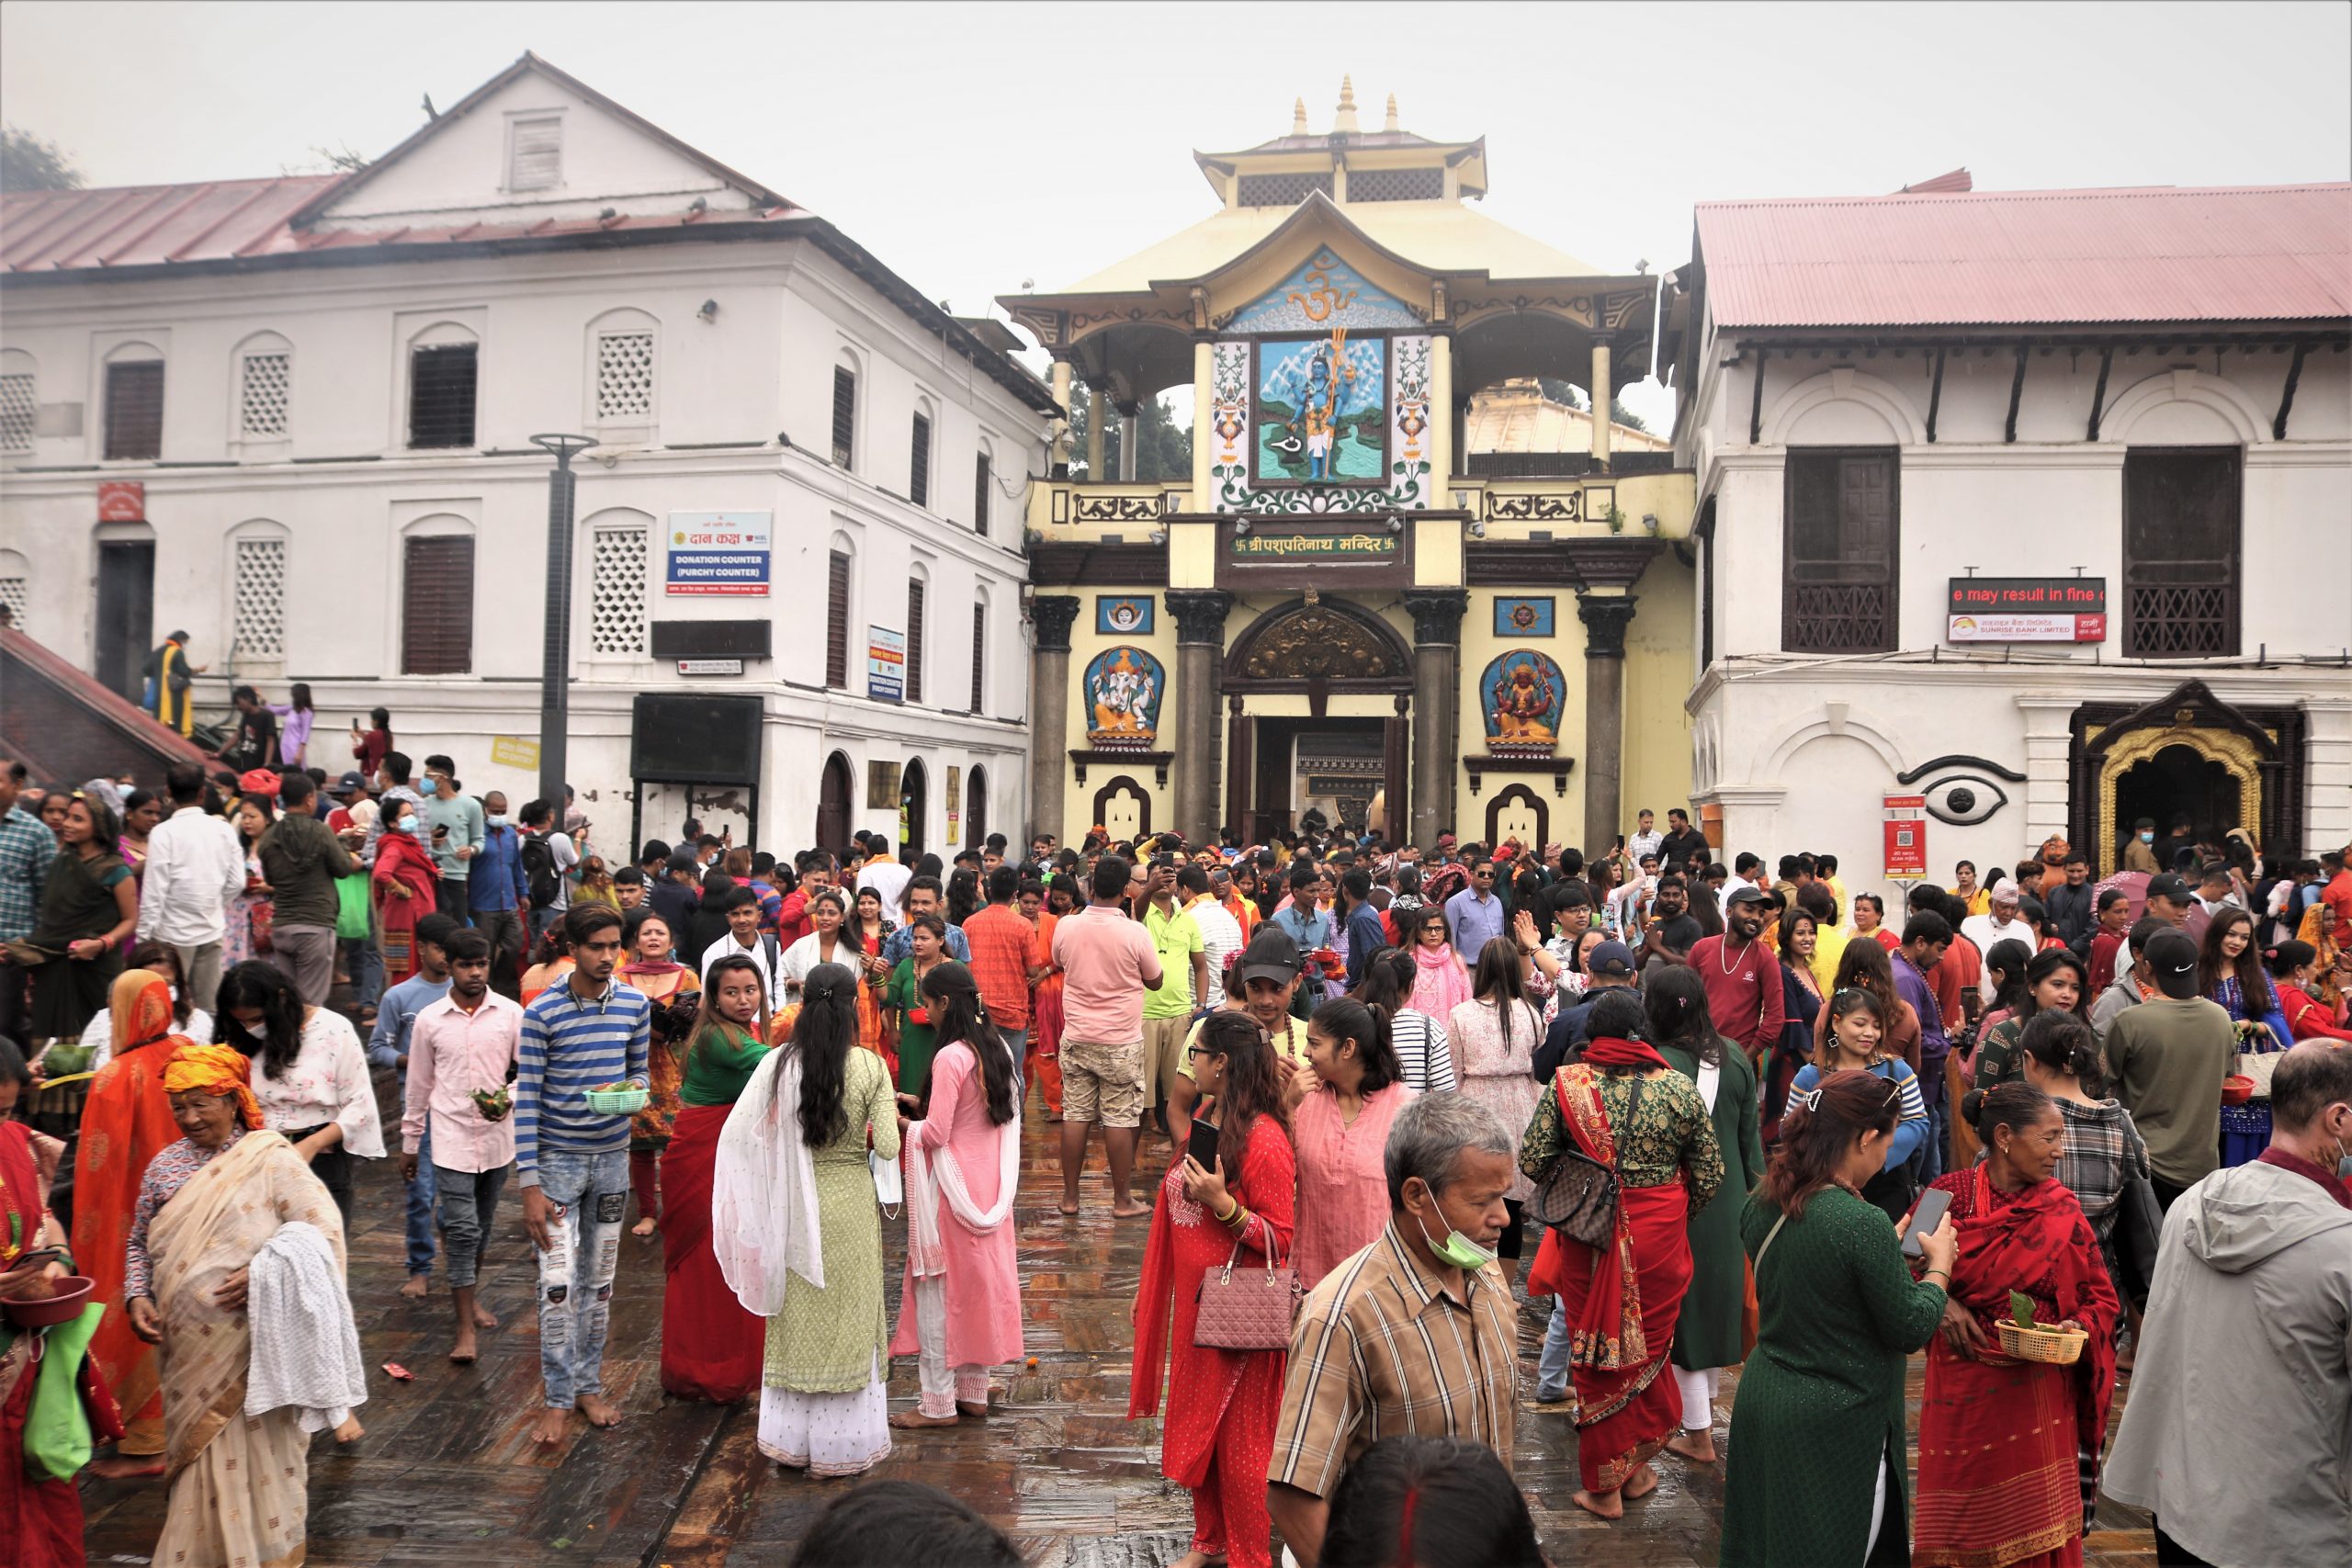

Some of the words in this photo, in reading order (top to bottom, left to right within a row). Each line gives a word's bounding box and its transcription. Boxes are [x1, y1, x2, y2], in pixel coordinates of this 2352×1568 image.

[690, 533, 712, 545] दान
[717, 533, 741, 545] कक्ष
[1339, 534, 1382, 551] मन्दिर
[675, 556, 719, 564] DONATION
[720, 556, 763, 564] COUNTER
[676, 568, 715, 577] (PURCHY
[716, 568, 760, 577] COUNTER)
[1967, 590, 1998, 604] may
[2003, 588, 2044, 602] result
[2049, 587, 2063, 602] in
[2066, 587, 2095, 602] fine
